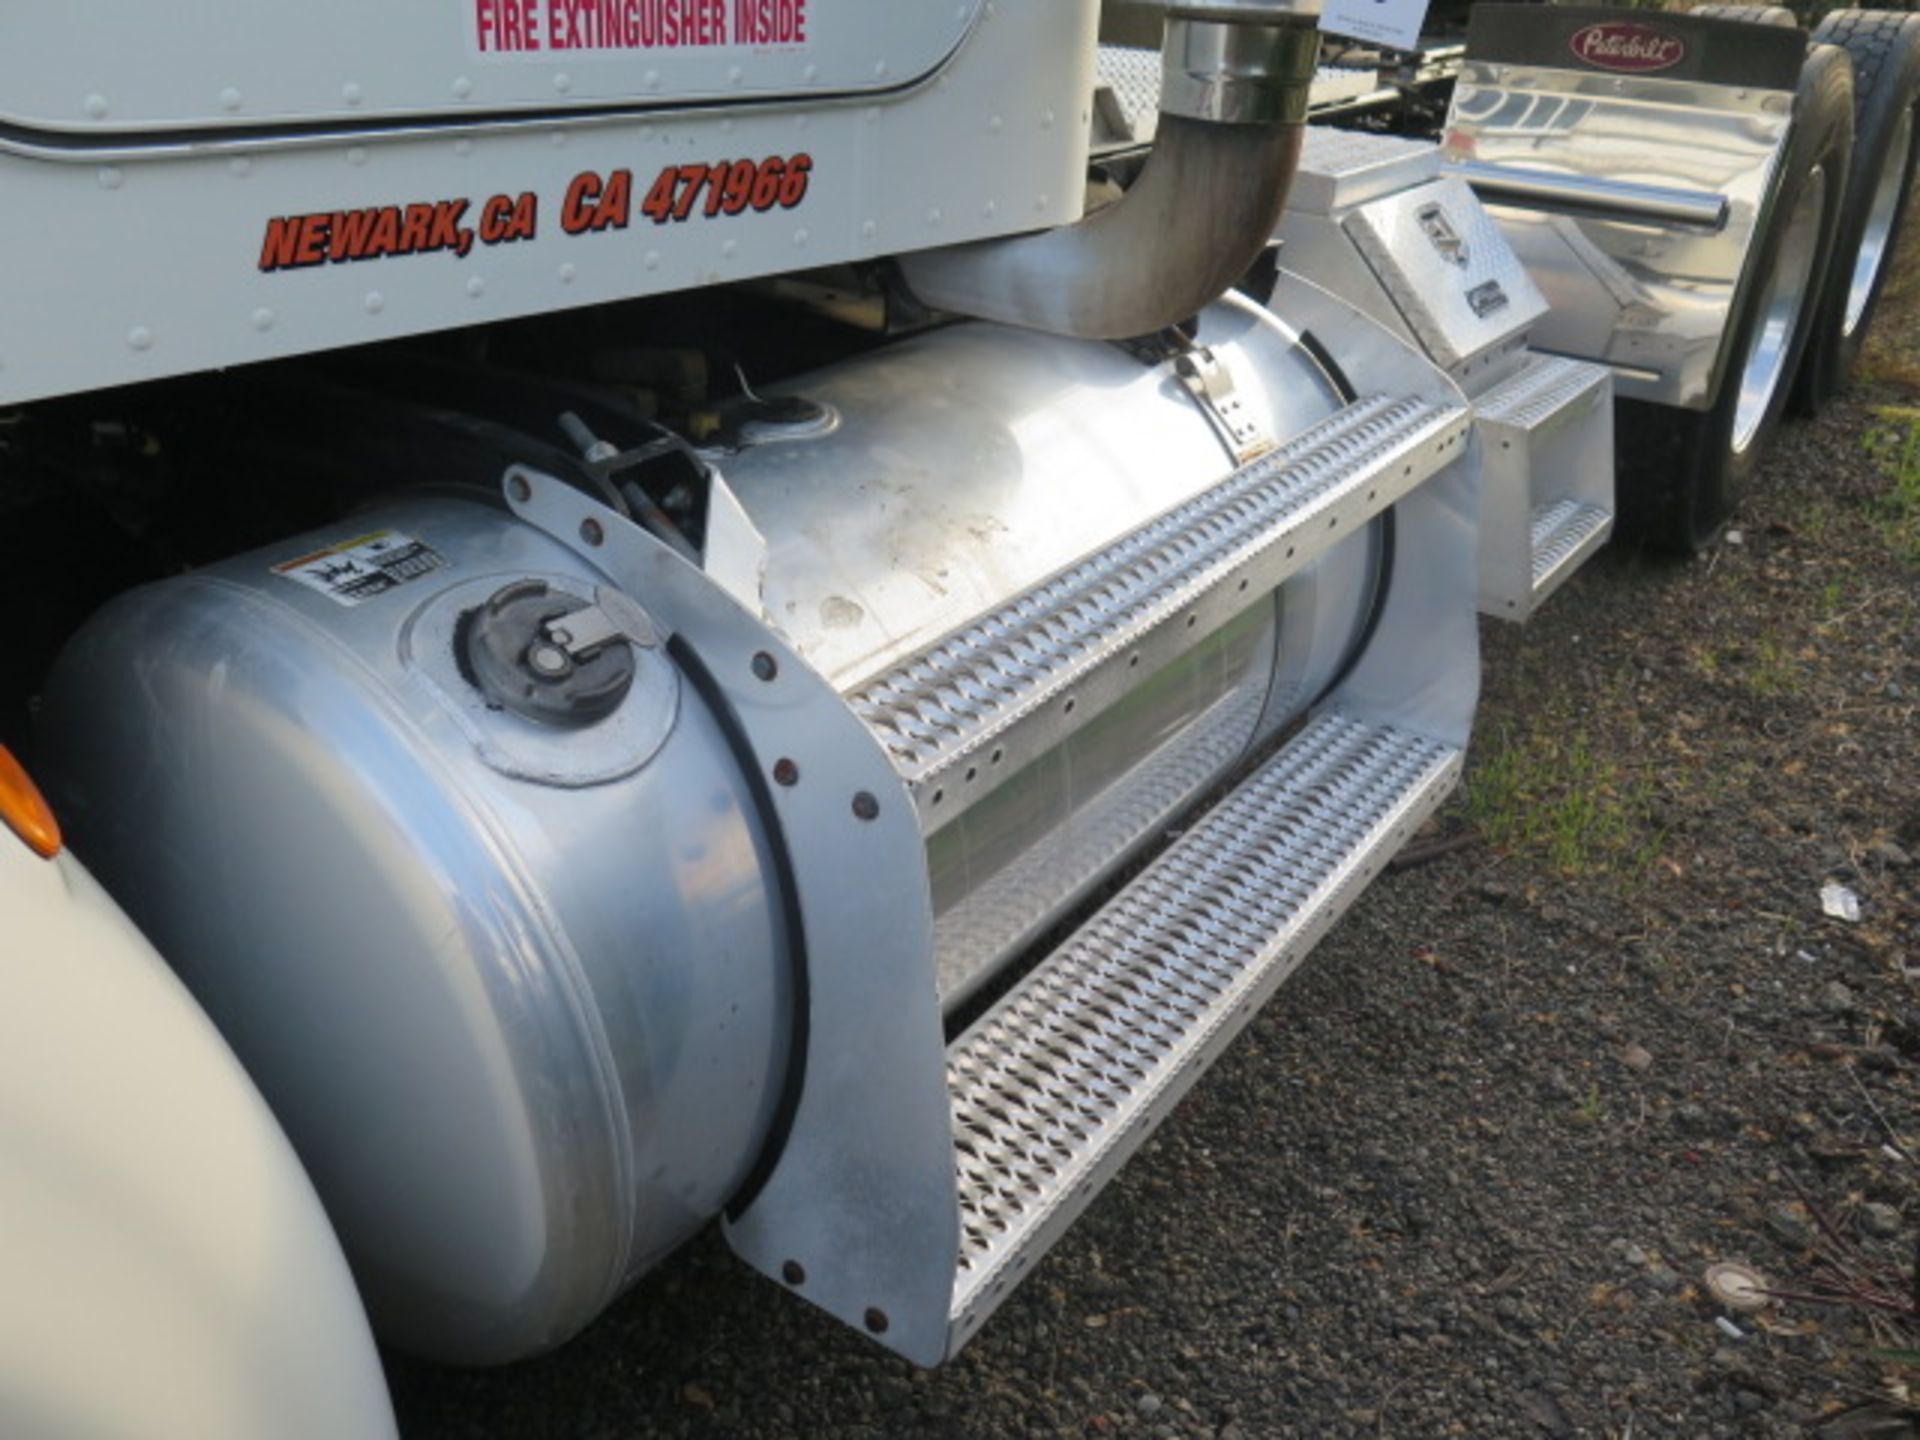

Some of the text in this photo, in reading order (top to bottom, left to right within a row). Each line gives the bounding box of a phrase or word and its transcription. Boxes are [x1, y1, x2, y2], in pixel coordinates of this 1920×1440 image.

[477, 0, 806, 51] FIRE EXTINGUISHER INSIDE
[1583, 28, 1676, 61] Peterbilt
[258, 153, 813, 271] NEWARK, CA CA 471966
